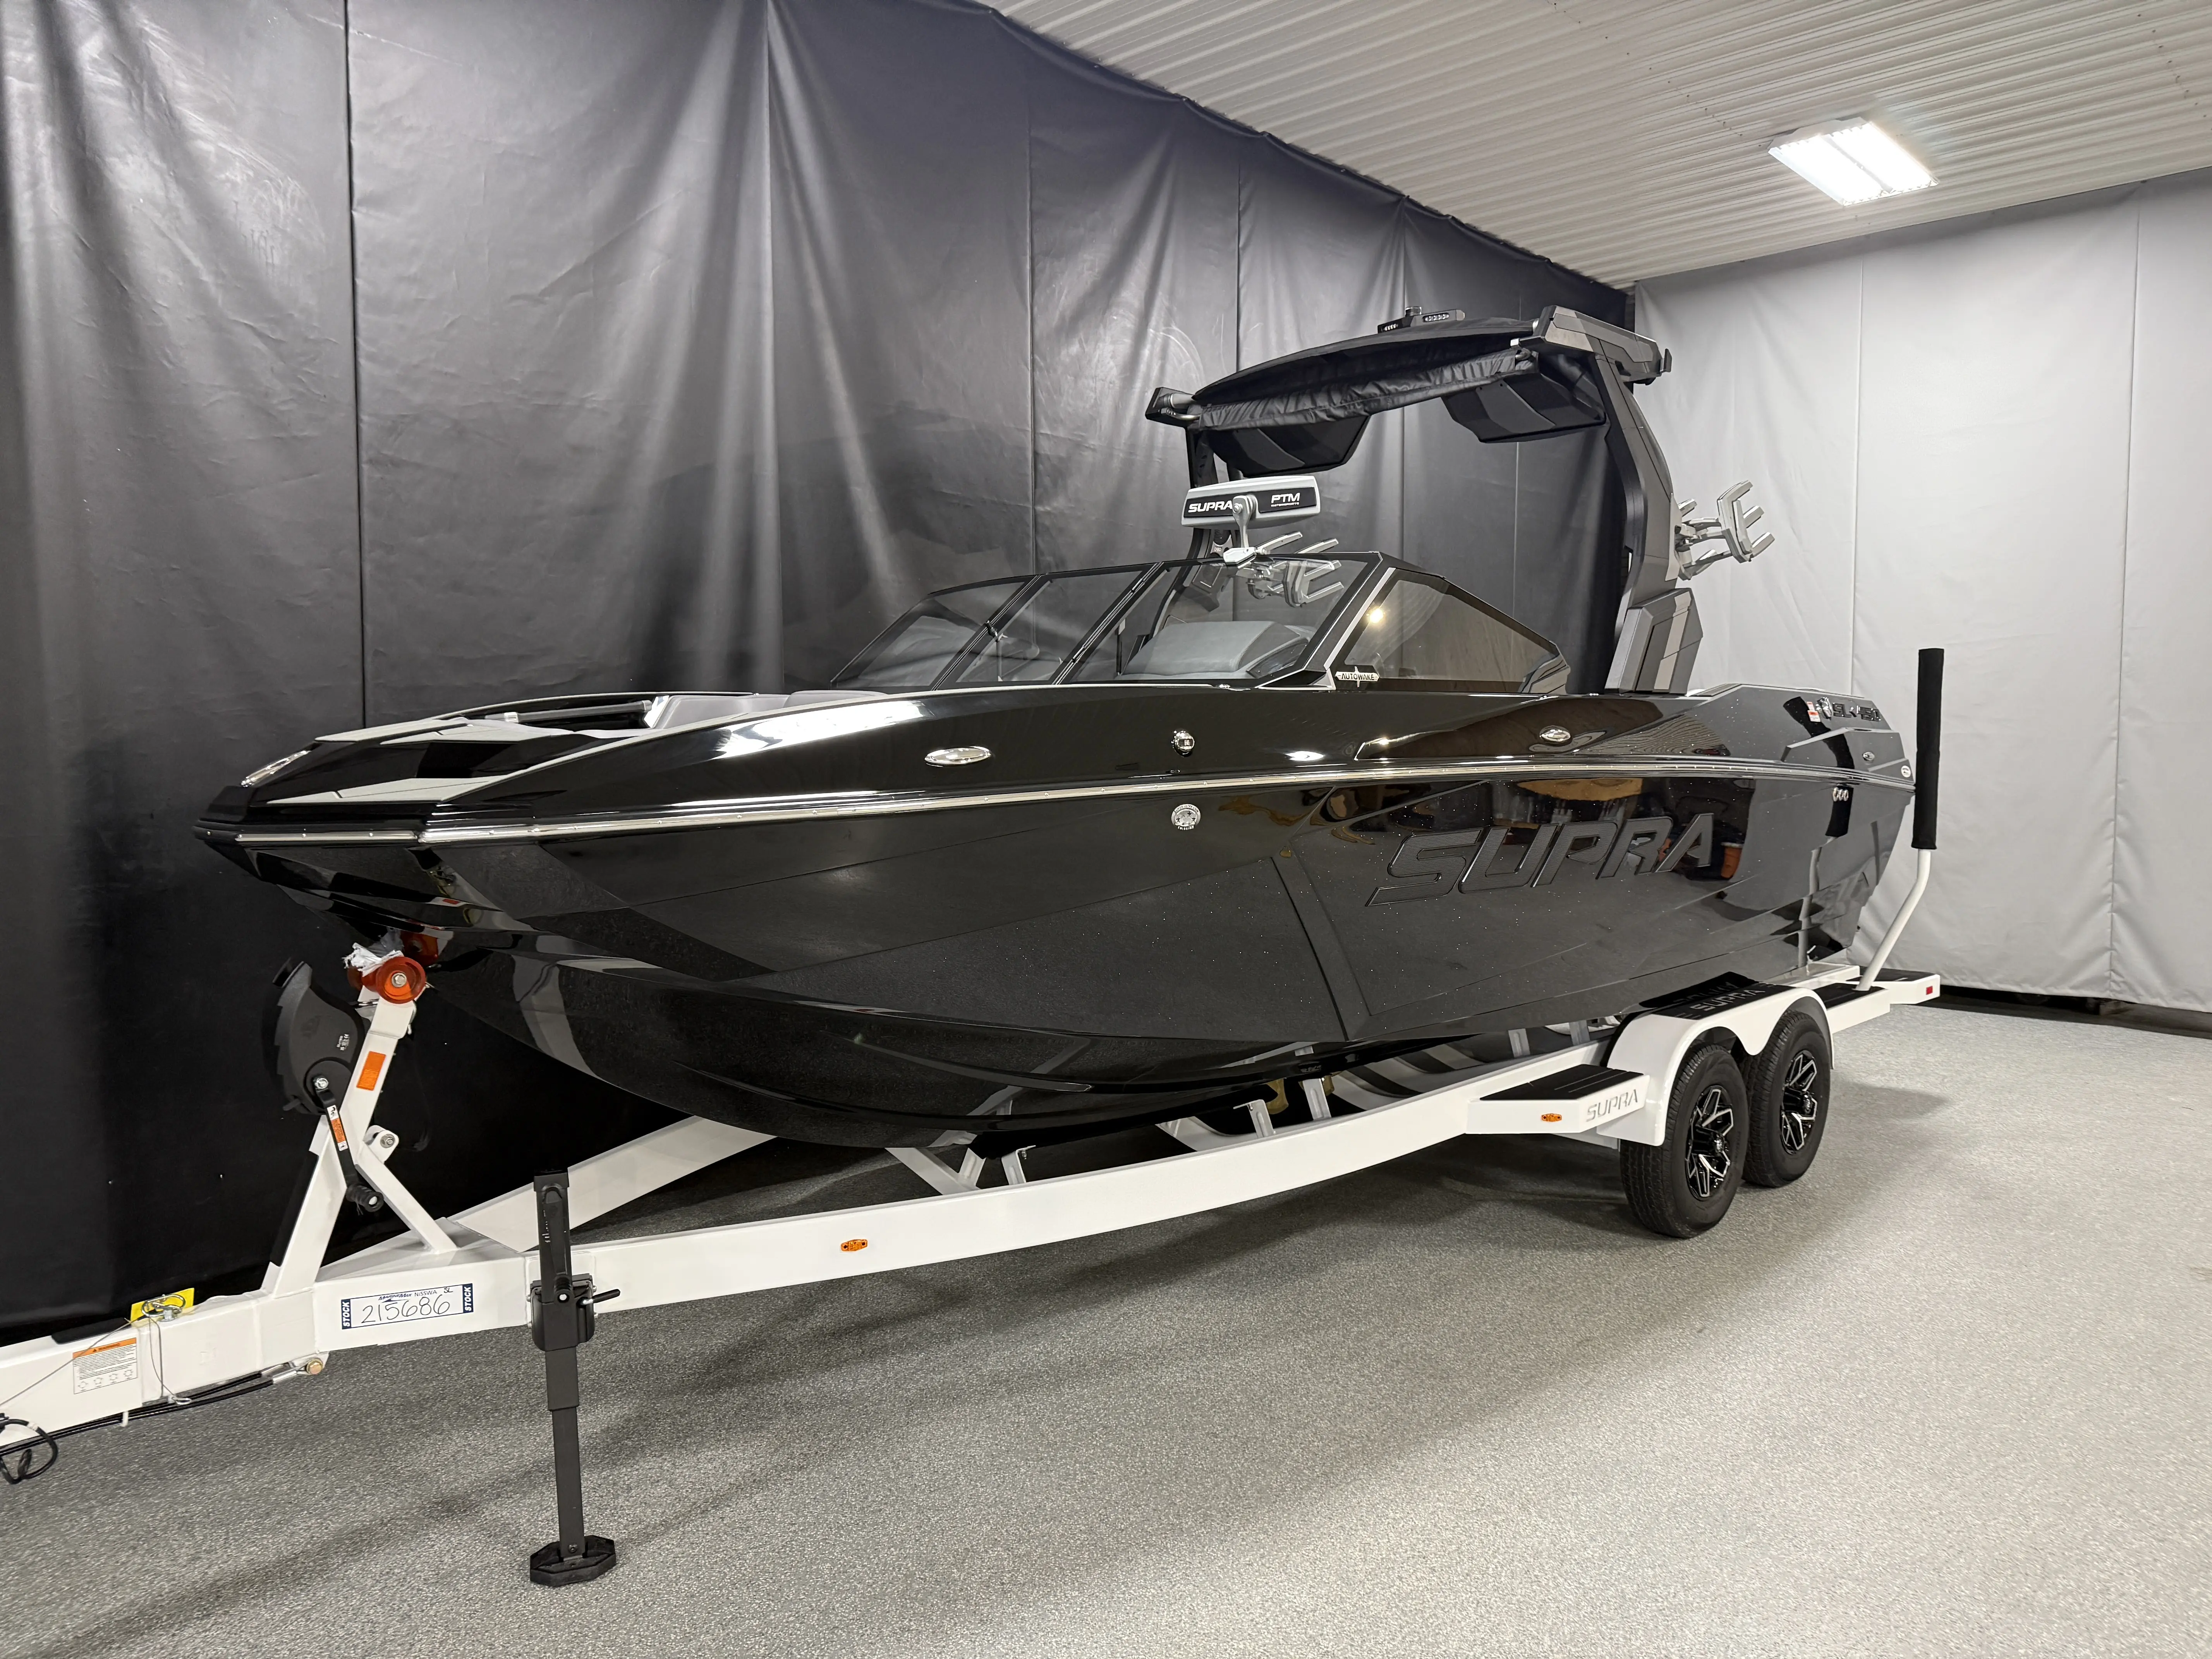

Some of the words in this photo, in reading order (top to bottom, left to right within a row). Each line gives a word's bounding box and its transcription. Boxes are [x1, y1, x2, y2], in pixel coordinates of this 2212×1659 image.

[1188, 500, 1233, 513] SUPRA
[1271, 493, 1300, 503] PTM
[1341, 673, 1375, 681] AUTOWAKE
[1365, 813, 1714, 907] SUPRA
[1690, 989, 1766, 1011] SUPRA
[1586, 1089, 1638, 1122] SUPRA
[361, 1294, 450, 1324] 215686
[464, 1286, 472, 1312] STOCK
[342, 1301, 350, 1327] STOCK
